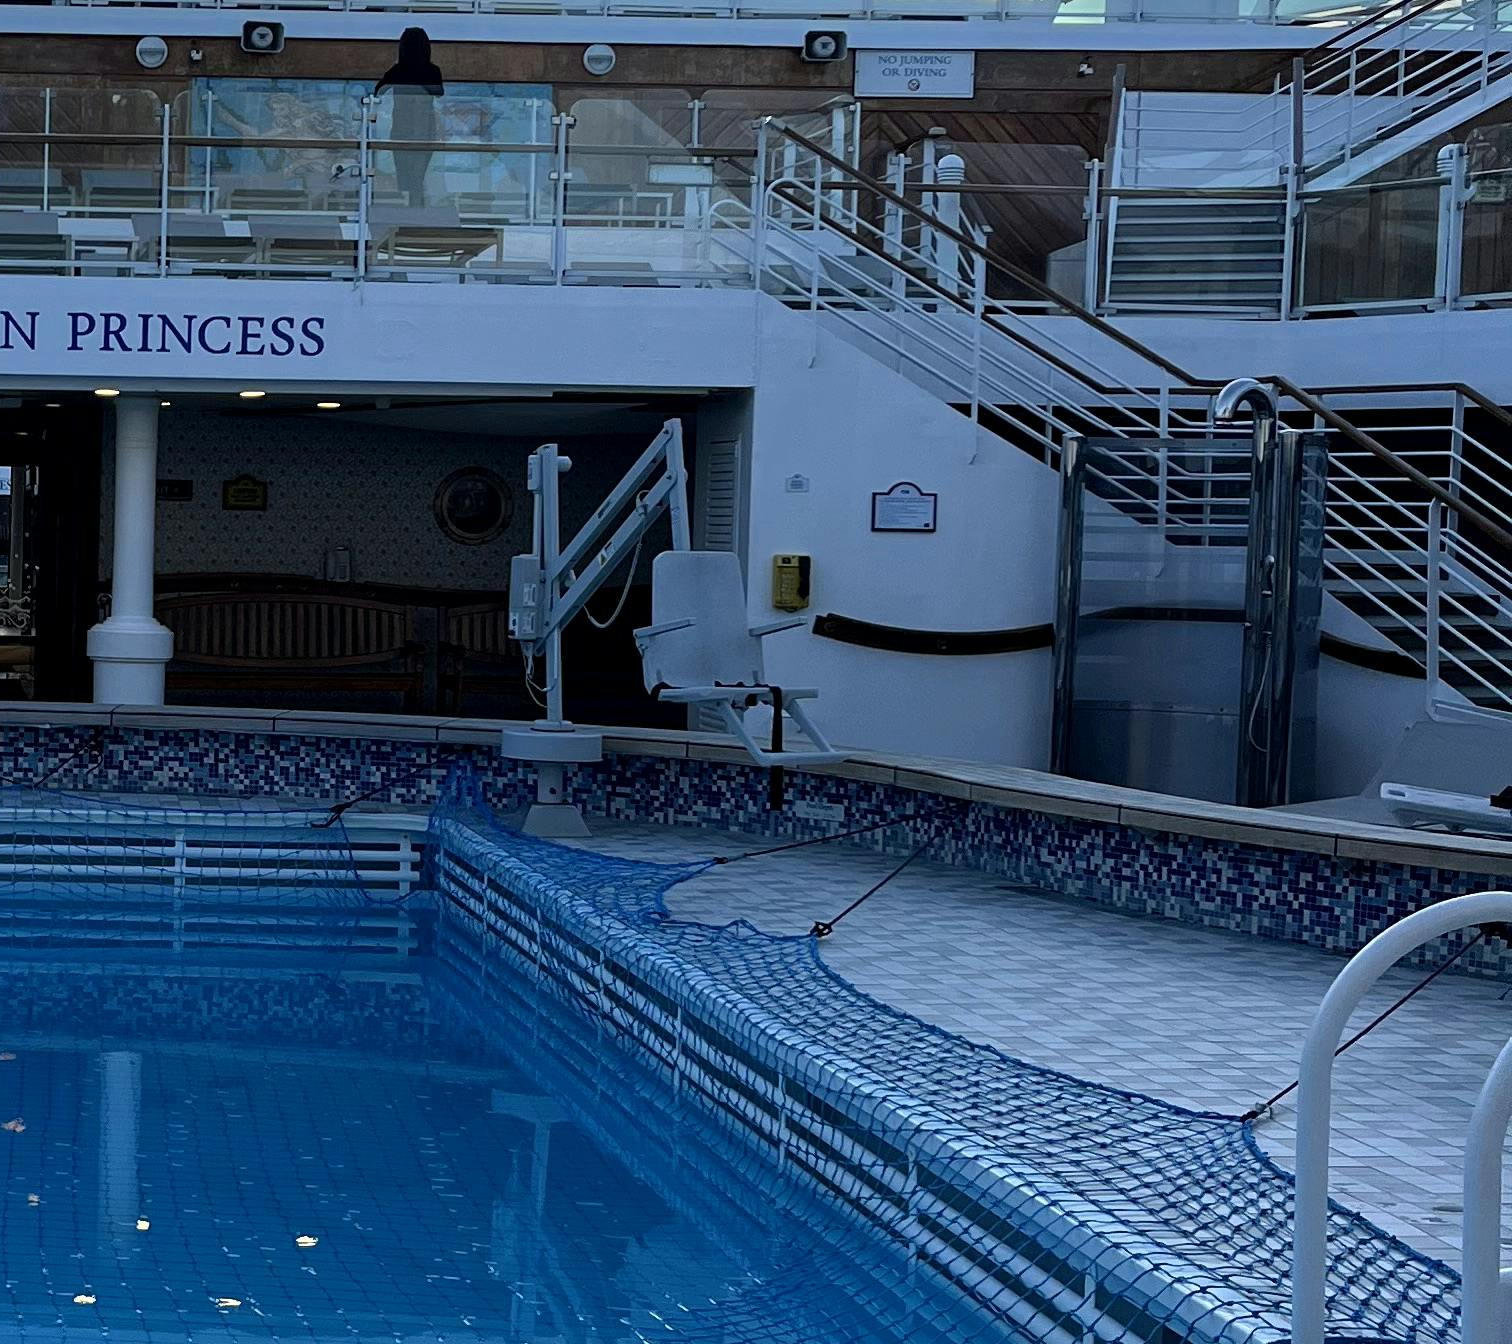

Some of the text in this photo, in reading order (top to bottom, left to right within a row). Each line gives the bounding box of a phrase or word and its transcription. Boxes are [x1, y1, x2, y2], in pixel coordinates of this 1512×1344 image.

[878, 55, 952, 66] NO JUMPING
[882, 67, 947, 78] OR DIVING
[66, 311, 326, 357] PRINCESS
